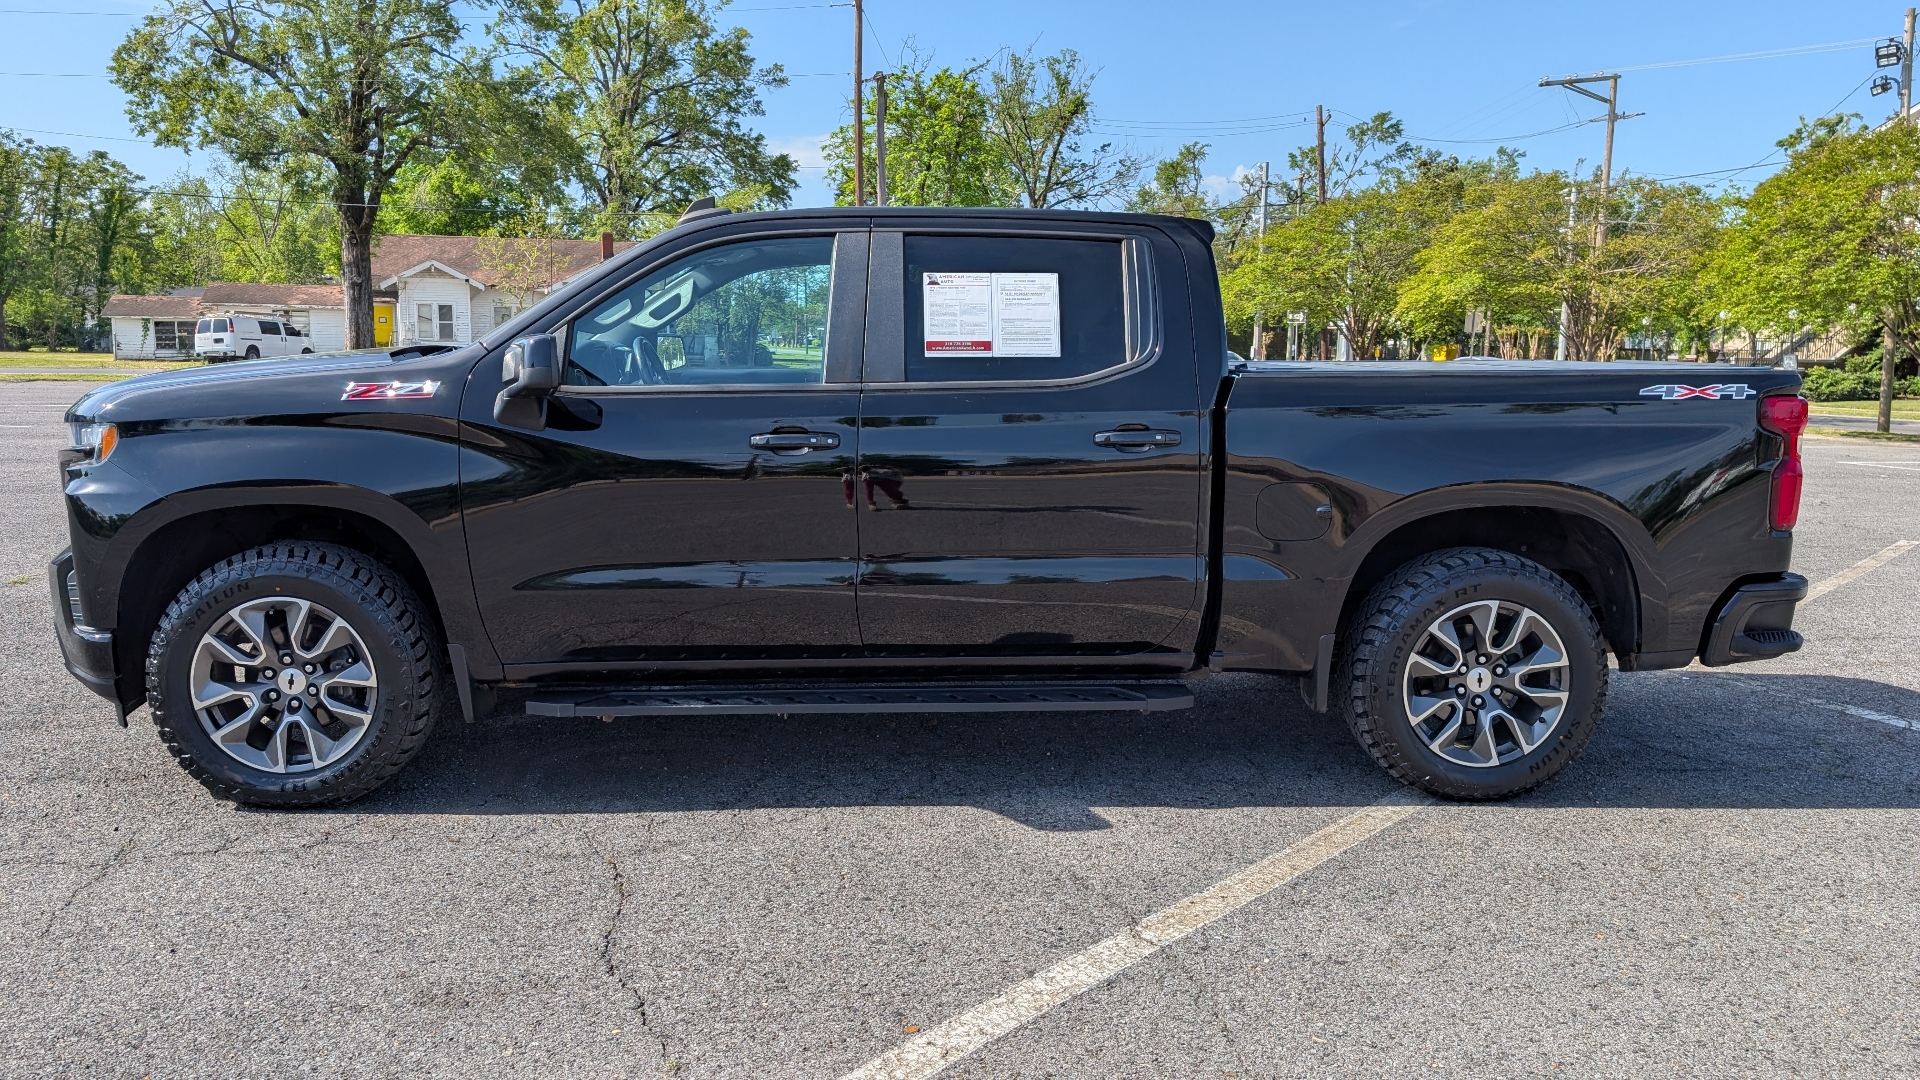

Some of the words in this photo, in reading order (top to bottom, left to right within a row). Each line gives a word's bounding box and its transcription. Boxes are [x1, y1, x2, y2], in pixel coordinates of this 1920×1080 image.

[341, 380, 441, 400] Z71
[185, 582, 249, 630] SAILUN
[1386, 598, 1446, 700] TERRAMAX
[1454, 584, 1482, 598] RT
[1529, 718, 1581, 774] SAILUN
